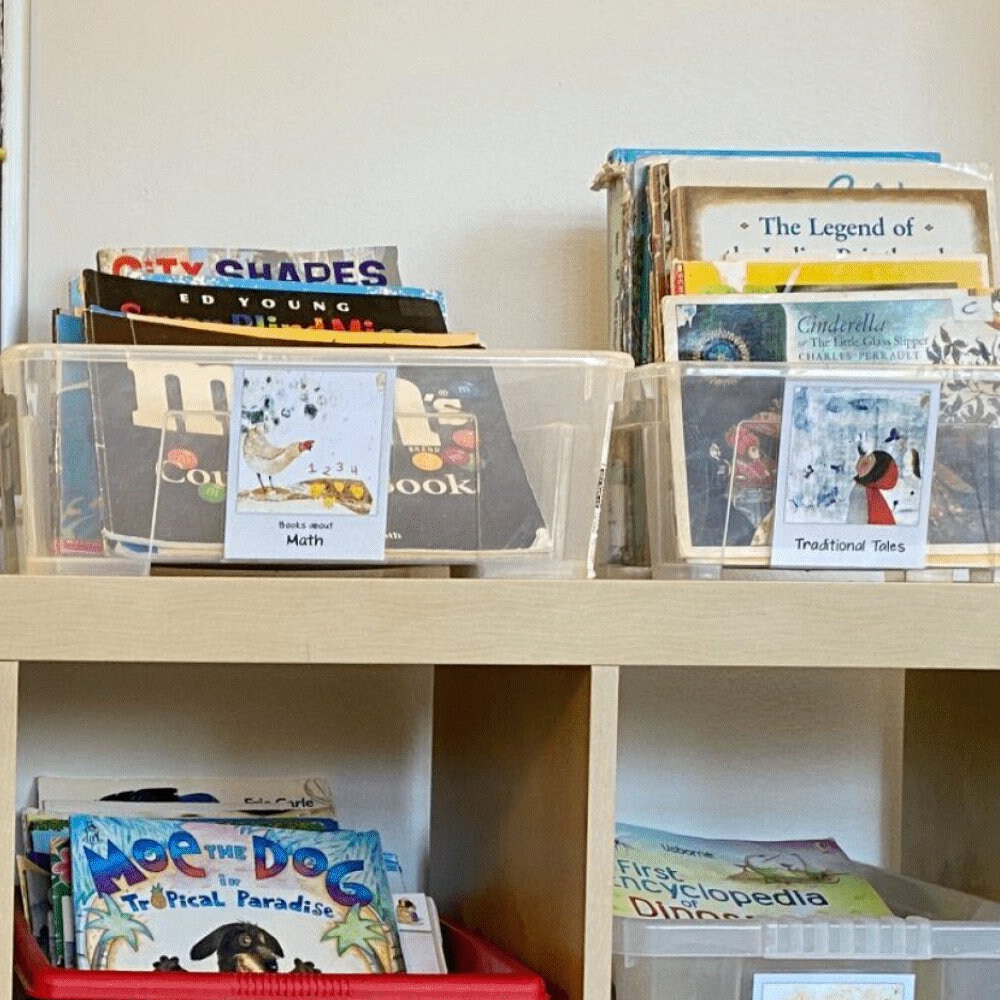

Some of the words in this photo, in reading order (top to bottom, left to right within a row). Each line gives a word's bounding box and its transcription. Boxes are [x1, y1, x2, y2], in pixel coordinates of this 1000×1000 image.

[758, 216, 801, 236] The
[809, 217, 885, 242] Legend
[893, 216, 915, 236] of
[179, 293, 215, 305] ED
[238, 297, 350, 312] YOUNG
[797, 312, 887, 334] Cinderella
[811, 337, 831, 348] The
[833, 336, 859, 348] Little
[862, 337, 891, 348] Glass
[894, 335, 929, 350] Slipper
[798, 351, 852, 362] CHARLES
[858, 351, 919, 361] PERRAULT
[388, 473, 477, 496] ook
[279, 521, 306, 530] Books
[287, 534, 324, 547] Math
[795, 538, 866, 552] Traditional
[872, 539, 906, 553] Tales
[203, 844, 248, 861] THE
[616, 858, 685, 883] First
[613, 875, 830, 908] ncyclopedia
